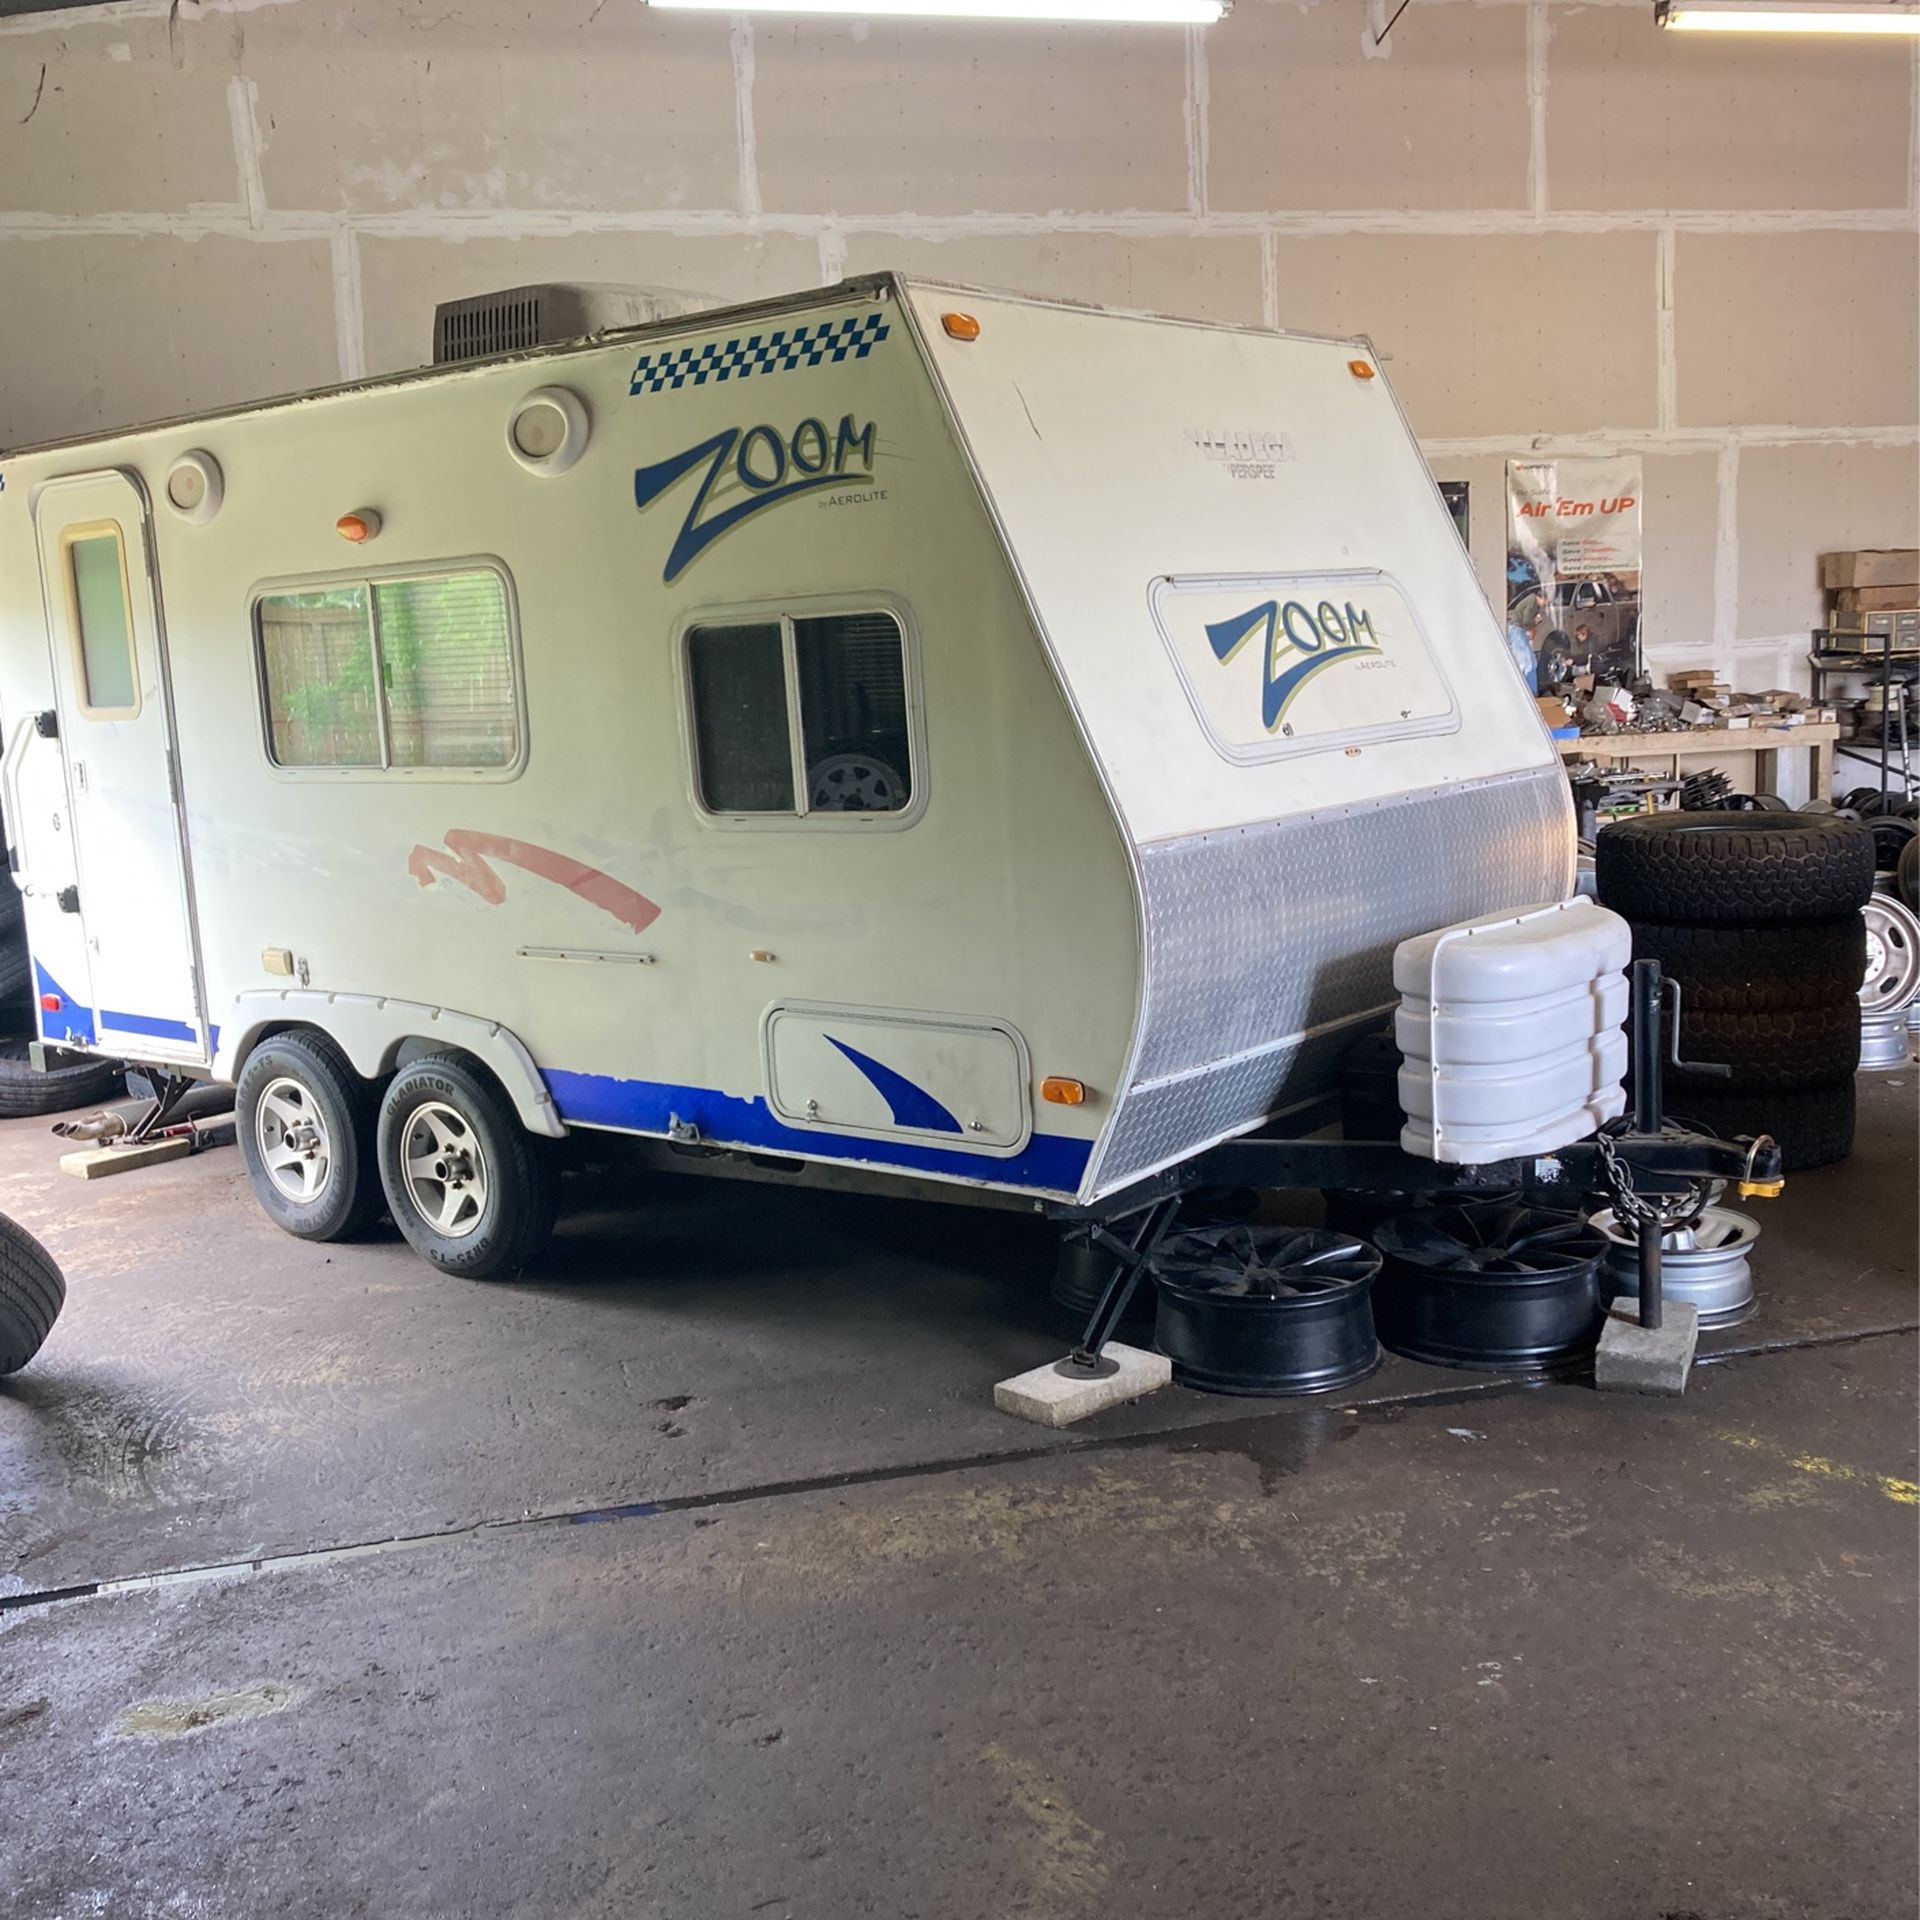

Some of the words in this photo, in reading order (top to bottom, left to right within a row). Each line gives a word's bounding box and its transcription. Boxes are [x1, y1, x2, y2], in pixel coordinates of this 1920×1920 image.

[635, 412, 876, 587] ZOOM
[828, 490, 888, 506] AEROLITE
[1518, 501, 1552, 517] Air
[1600, 498, 1635, 514] UP
[1205, 600, 1384, 734] ZOOM
[386, 1075, 456, 1117] GLADIATOR
